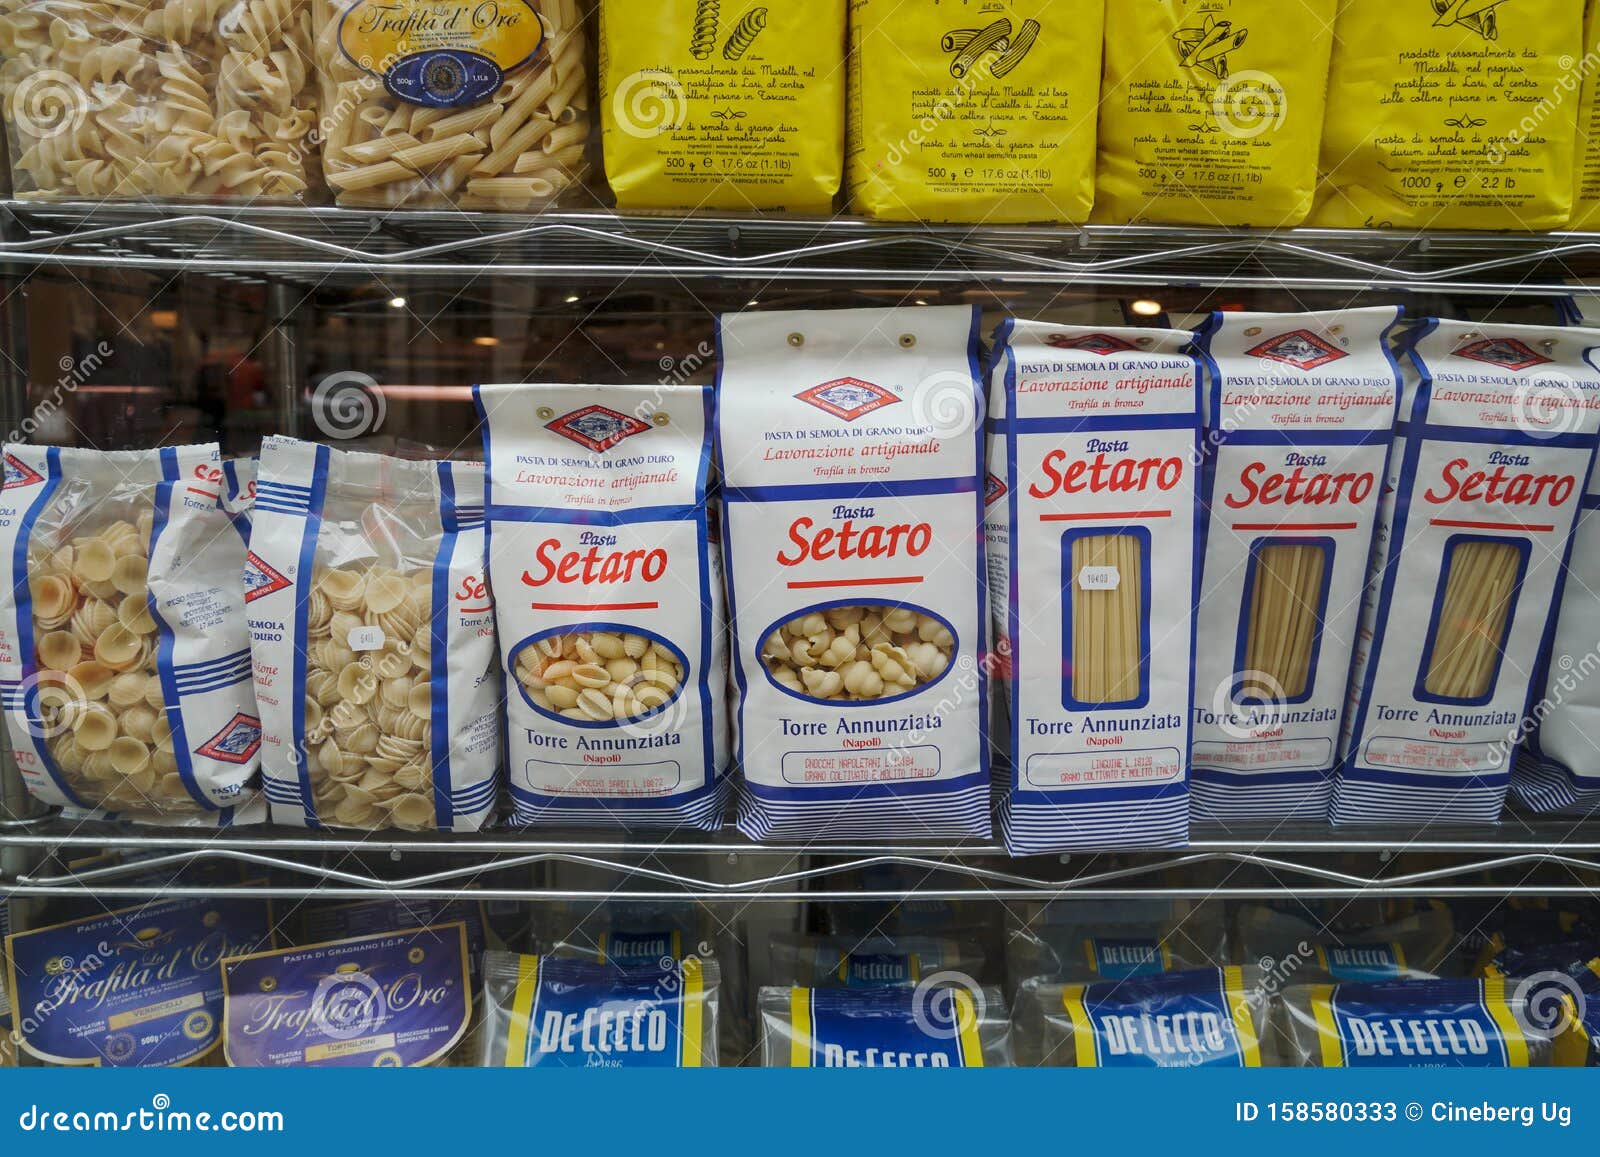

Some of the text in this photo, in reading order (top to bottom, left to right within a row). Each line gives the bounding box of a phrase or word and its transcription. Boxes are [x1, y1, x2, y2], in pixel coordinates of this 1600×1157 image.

[359, 6, 438, 41] Trafila
[1446, 47, 1516, 63] personalmente
[1522, 48, 1538, 58] dai
[678, 65, 738, 79] personalmente
[742, 66, 756, 76] dai
[803, 67, 816, 77] nel
[1465, 61, 1481, 73] nel
[1487, 66, 1525, 79] proprio
[1393, 76, 1440, 93] pastificio
[1446, 77, 1456, 87] di
[1493, 76, 1504, 87] al
[1509, 78, 1539, 88] centro
[1380, 91, 1405, 104] delle
[1410, 91, 1443, 102] colline
[1449, 95, 1482, 107] pisane
[1504, 90, 1546, 103] Toscana
[1134, 135, 1272, 149] pasta di semola di grano duro
[666, 157, 685, 168] 500
[722, 159, 744, 169] 17.6
[746, 159, 758, 169] oz
[928, 168, 947, 178] 500
[983, 169, 1005, 179] 17.6
[1007, 170, 1019, 179] oz
[1401, 176, 1431, 189] 1000
[1480, 176, 1499, 189] 2.2
[1505, 176, 1516, 189] lb
[1020, 360, 1190, 373] PASTA DI SEMOLA DI GRANO DURO
[1018, 373, 1193, 394] Lavorazione artigianale
[1222, 390, 1393, 410] Lavorazione artigianale
[1432, 388, 1519, 404] Lavorazione
[1068, 398, 1144, 411] Trafila in bronzo
[764, 425, 934, 441] PASTA DI SEMOLA DI GRANO DURO
[763, 438, 940, 461] Lavorazione artigianale
[1086, 438, 1129, 453] Pasta
[517, 455, 675, 469] PASTA DI SEMOLA DI GRANO DURO
[1285, 452, 1328, 466] Pasta
[1488, 451, 1530, 466] Pasta
[814, 464, 890, 477] Trafila in bronzo
[1028, 449, 1183, 499] Setaro
[516, 468, 678, 490] Lavorazione artigianale
[1224, 461, 1374, 509] Setaro
[1424, 458, 1576, 507] Setaro
[832, 505, 875, 519] Pasta
[579, 531, 617, 546] Pasta
[776, 516, 932, 567] Setaro
[521, 538, 668, 587] Setaro
[254, 632, 282, 642] DURO
[1194, 707, 1337, 725] Torre Annunziata
[1376, 705, 1517, 726] Torre Annunziata
[779, 714, 942, 736] Torre Annunziata
[1026, 714, 1181, 735] Torre Annunziata
[524, 728, 681, 750] Torre Annunziata
[842, 737, 881, 749] (Napoli)
[1086, 735, 1123, 747] (Napoli)
[583, 754, 621, 763] (Napoli)
[283, 952, 312, 963] PASTA
[315, 951, 325, 959] DI
